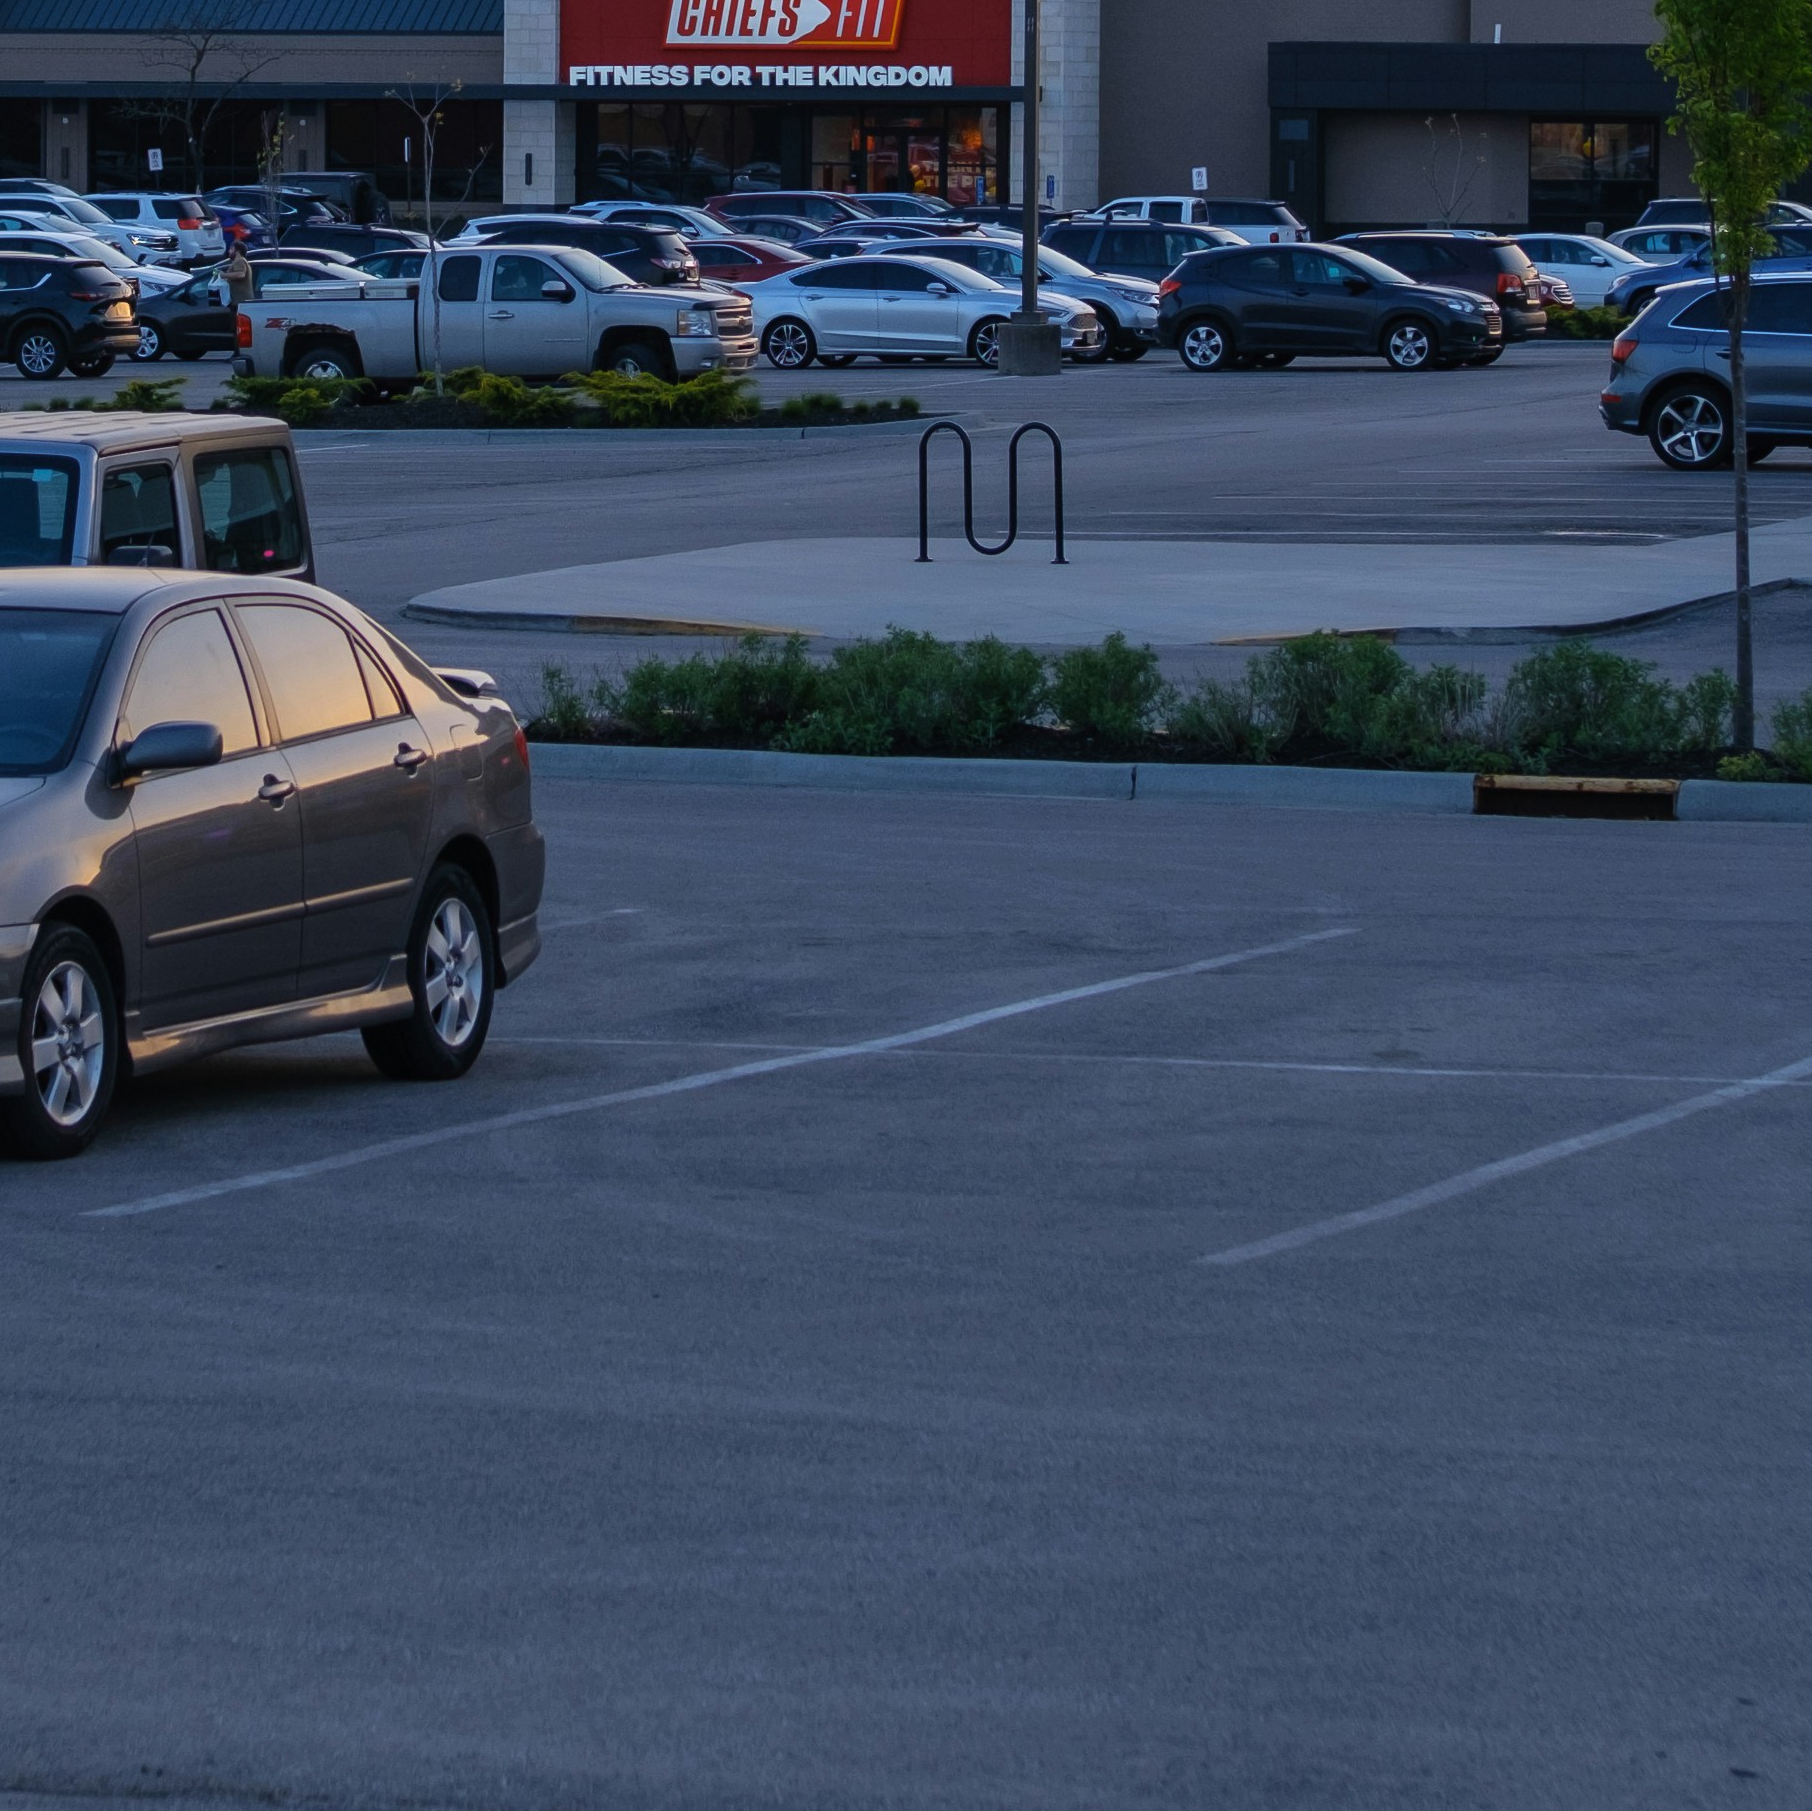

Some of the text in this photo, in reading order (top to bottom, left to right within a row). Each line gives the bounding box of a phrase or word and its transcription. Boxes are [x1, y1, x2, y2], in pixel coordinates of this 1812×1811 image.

[569, 64, 953, 87] FITNESS FOR THE KINGDOM
